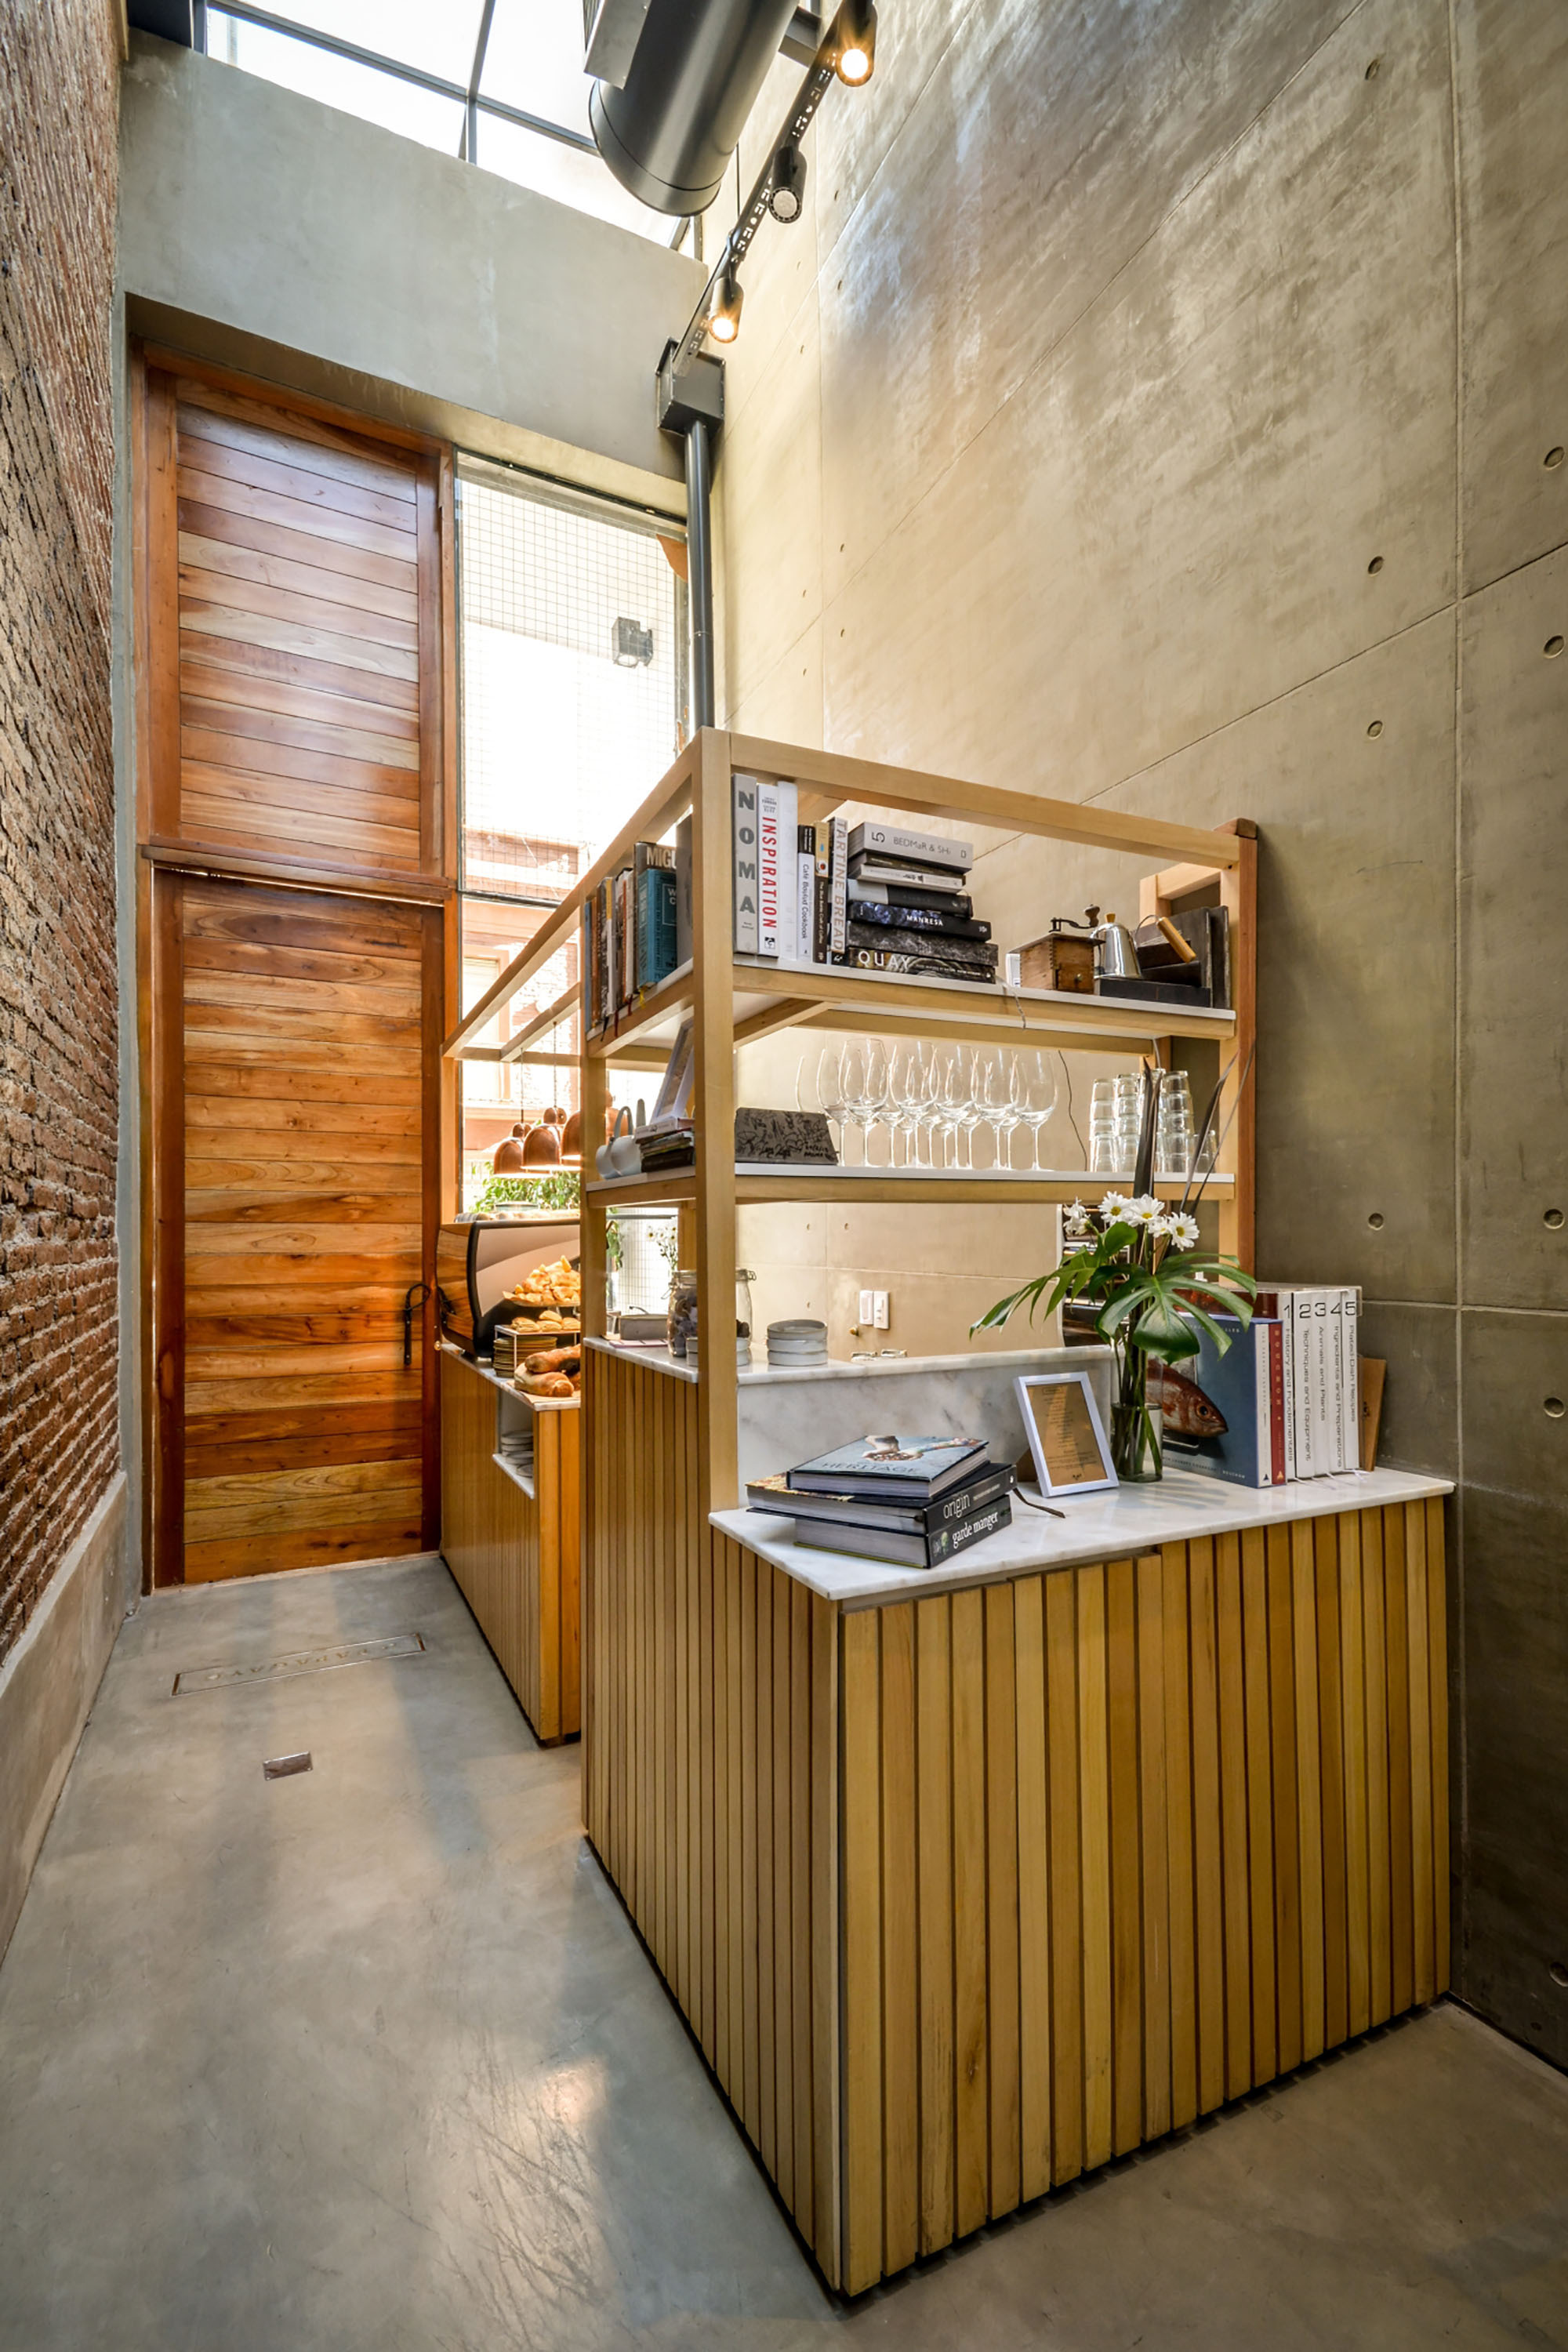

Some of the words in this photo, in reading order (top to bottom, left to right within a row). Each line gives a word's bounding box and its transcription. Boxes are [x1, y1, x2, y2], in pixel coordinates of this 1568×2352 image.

[739, 790, 756, 914] NOMA
[761, 816, 778, 928] INSPIRATION
[834, 821, 848, 891] TARTINE
[833, 895, 844, 951] BREAD
[906, 915, 944, 927] MANRESA
[858, 950, 910, 970] QUAY
[1283, 1305, 1290, 1319] 1
[1298, 1304, 1312, 1319] 2
[1315, 1302, 1327, 1316] 3
[1330, 1303, 1341, 1315] 4
[1345, 1301, 1356, 1316] 5
[1302, 1329, 1311, 1383] Techniques
[1286, 1390, 1294, 1461] Fundamentals
[1303, 1407, 1312, 1461] Equipment
[1334, 1403, 1344, 1468] Preparations
[822, 1461, 922, 1474] HERITAGE
[942, 1493, 971, 1519] origin
[952, 1523, 972, 1549] garde
[973, 1511, 998, 1532] manger
